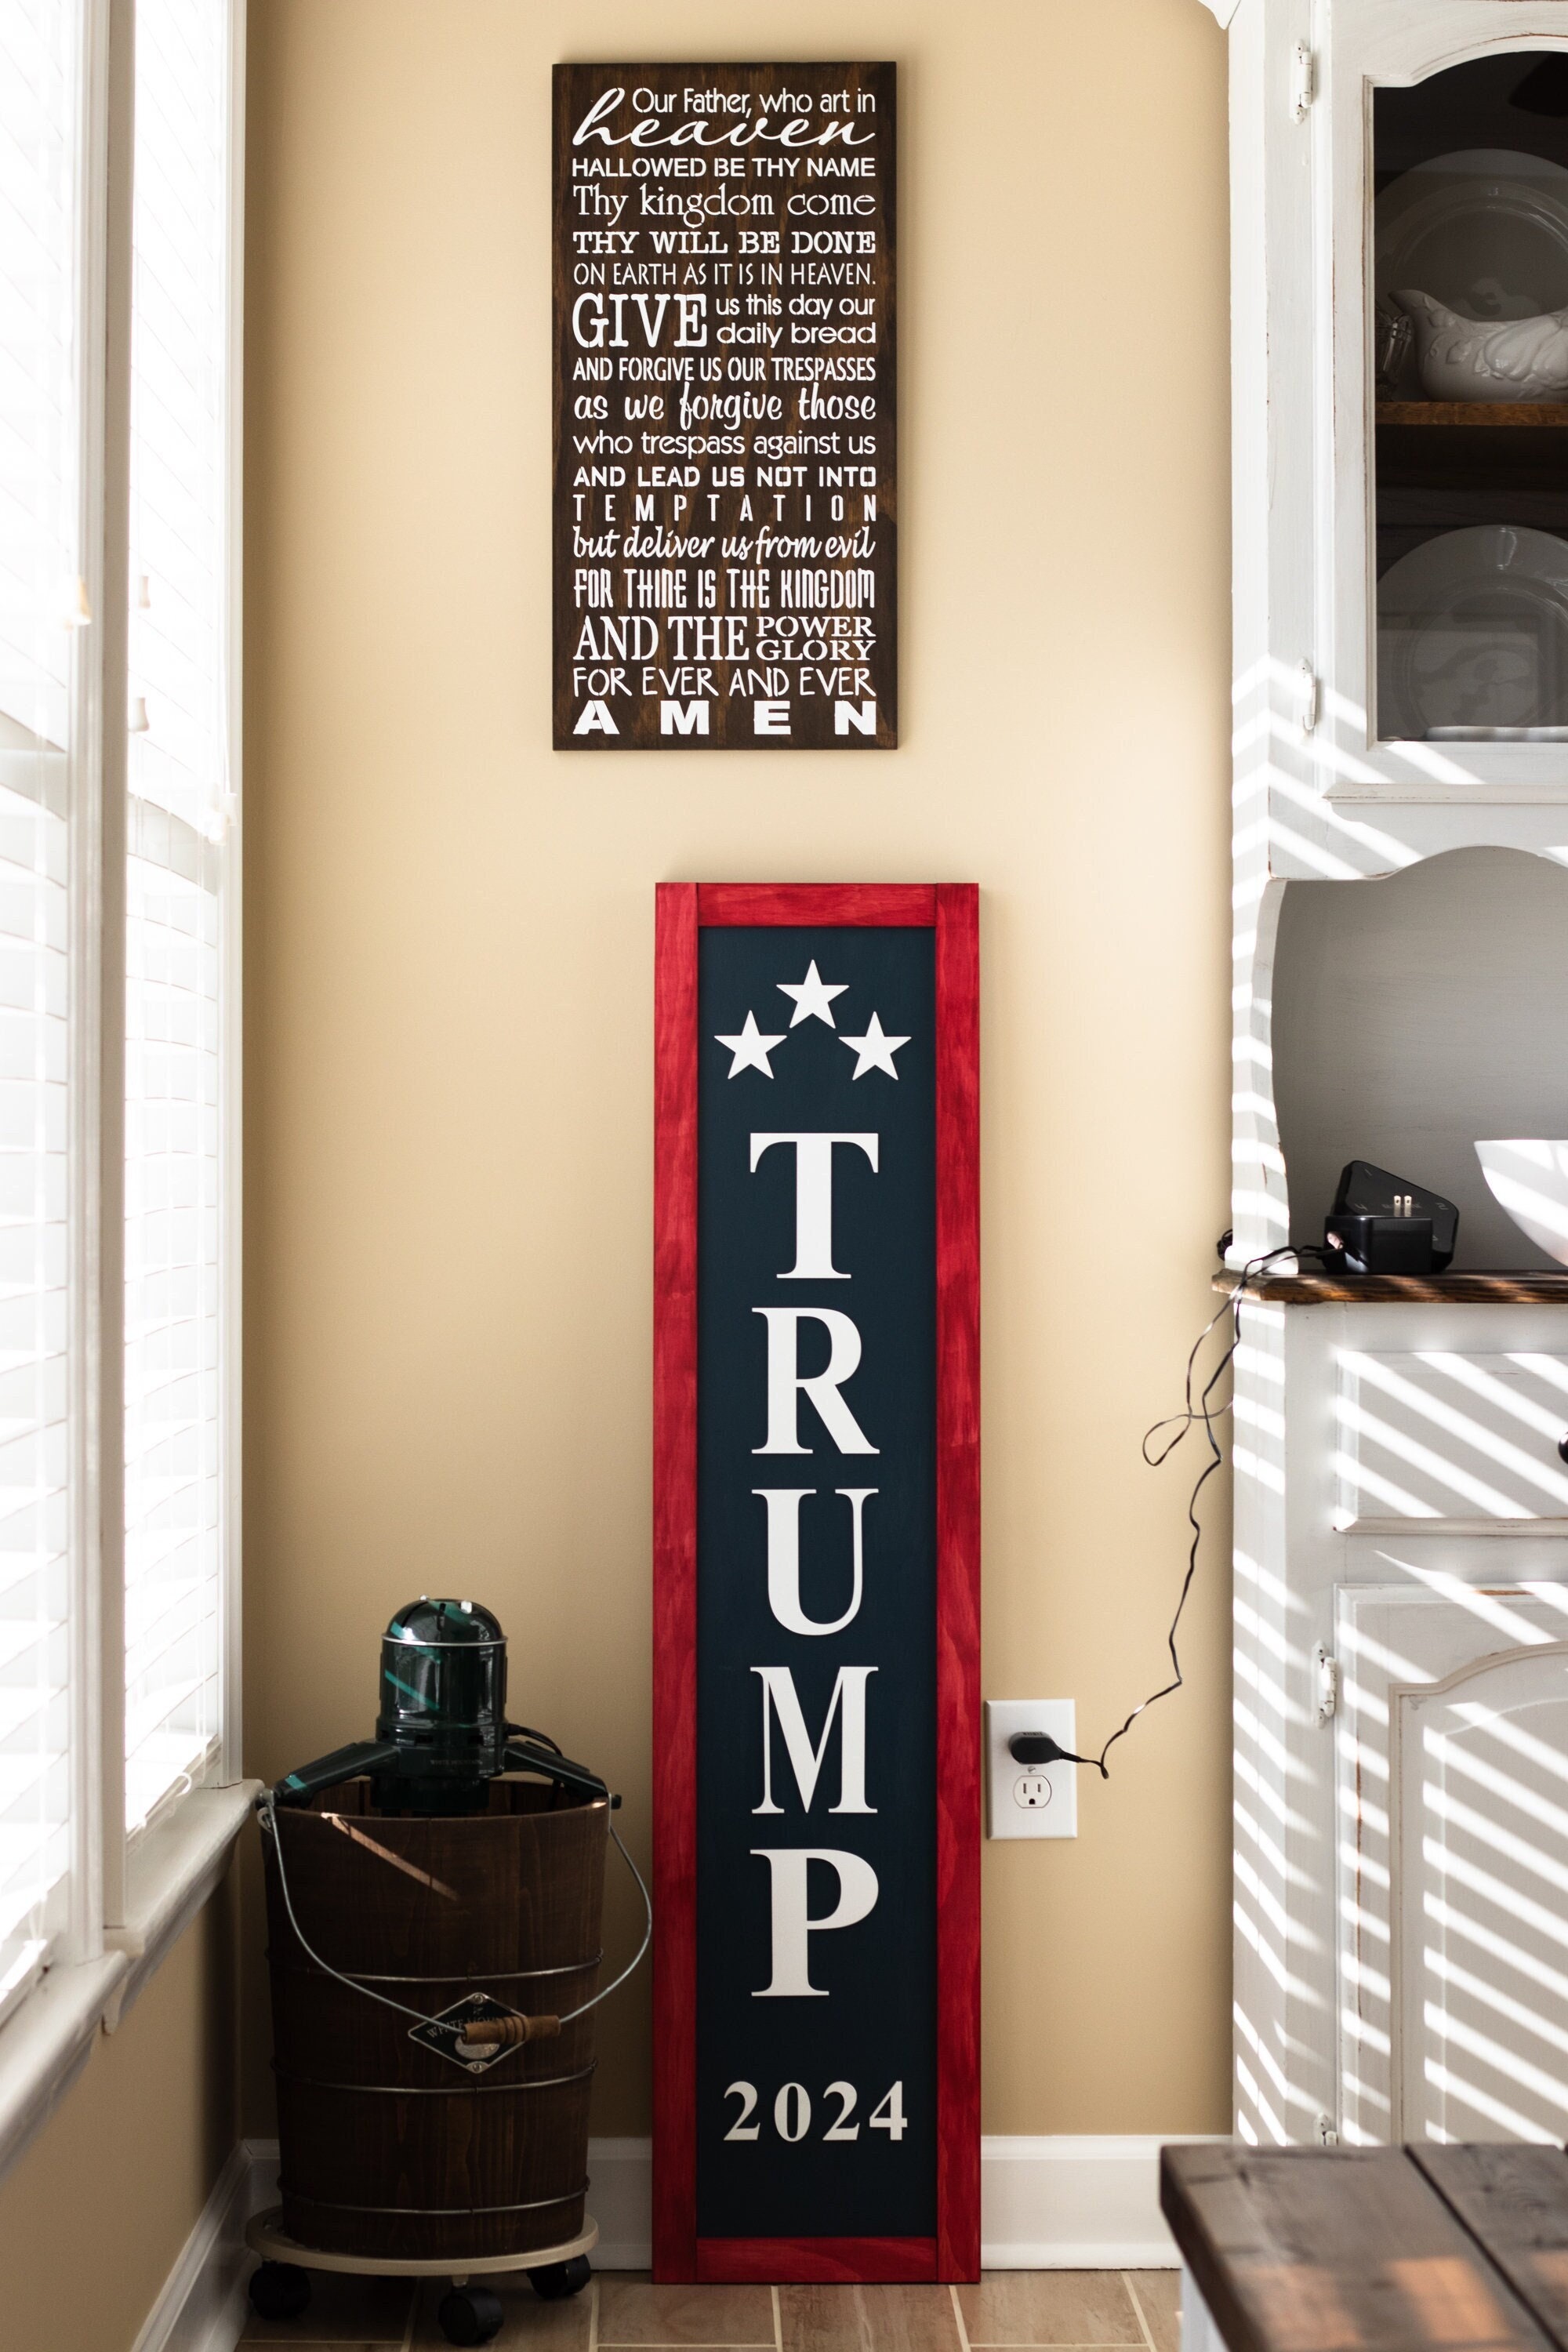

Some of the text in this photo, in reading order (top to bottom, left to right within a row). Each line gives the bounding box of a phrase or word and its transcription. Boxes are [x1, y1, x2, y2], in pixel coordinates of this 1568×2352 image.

[572, 88, 876, 147] heaven
[633, 88, 876, 119] Our Father, who art in
[572, 158, 877, 177] HALLOWED BE THY NAME
[573, 183, 877, 229] Thy kingdom come
[573, 231, 877, 254] THY WILL BE DONE
[573, 263, 877, 285] ON EARTH AS IT IS IN HEAVEN.
[572, 292, 708, 349] GIVE
[716, 294, 877, 320] us this day our
[716, 322, 877, 349] daily bread
[572, 358, 877, 382] AND FORGIVE US OUR TRESPASSES
[574, 382, 877, 431] as we forgive those
[572, 430, 877, 460] who trespass against us
[572, 466, 877, 488] AND LEAD US NOT INTO
[572, 495, 877, 522] TEMPTATION
[572, 525, 877, 565] but deliver us from evil
[573, 568, 875, 609] FOR THINE IS THE KINGDOM
[572, 615, 750, 661] AND THE
[756, 615, 877, 637] POWER
[756, 639, 877, 661] GLORY
[572, 667, 877, 698] FOR EVER AND EVER
[572, 700, 877, 735] AMEN
[750, 1132, 880, 1996] TRUMP
[724, 2081, 908, 2142] 2024
